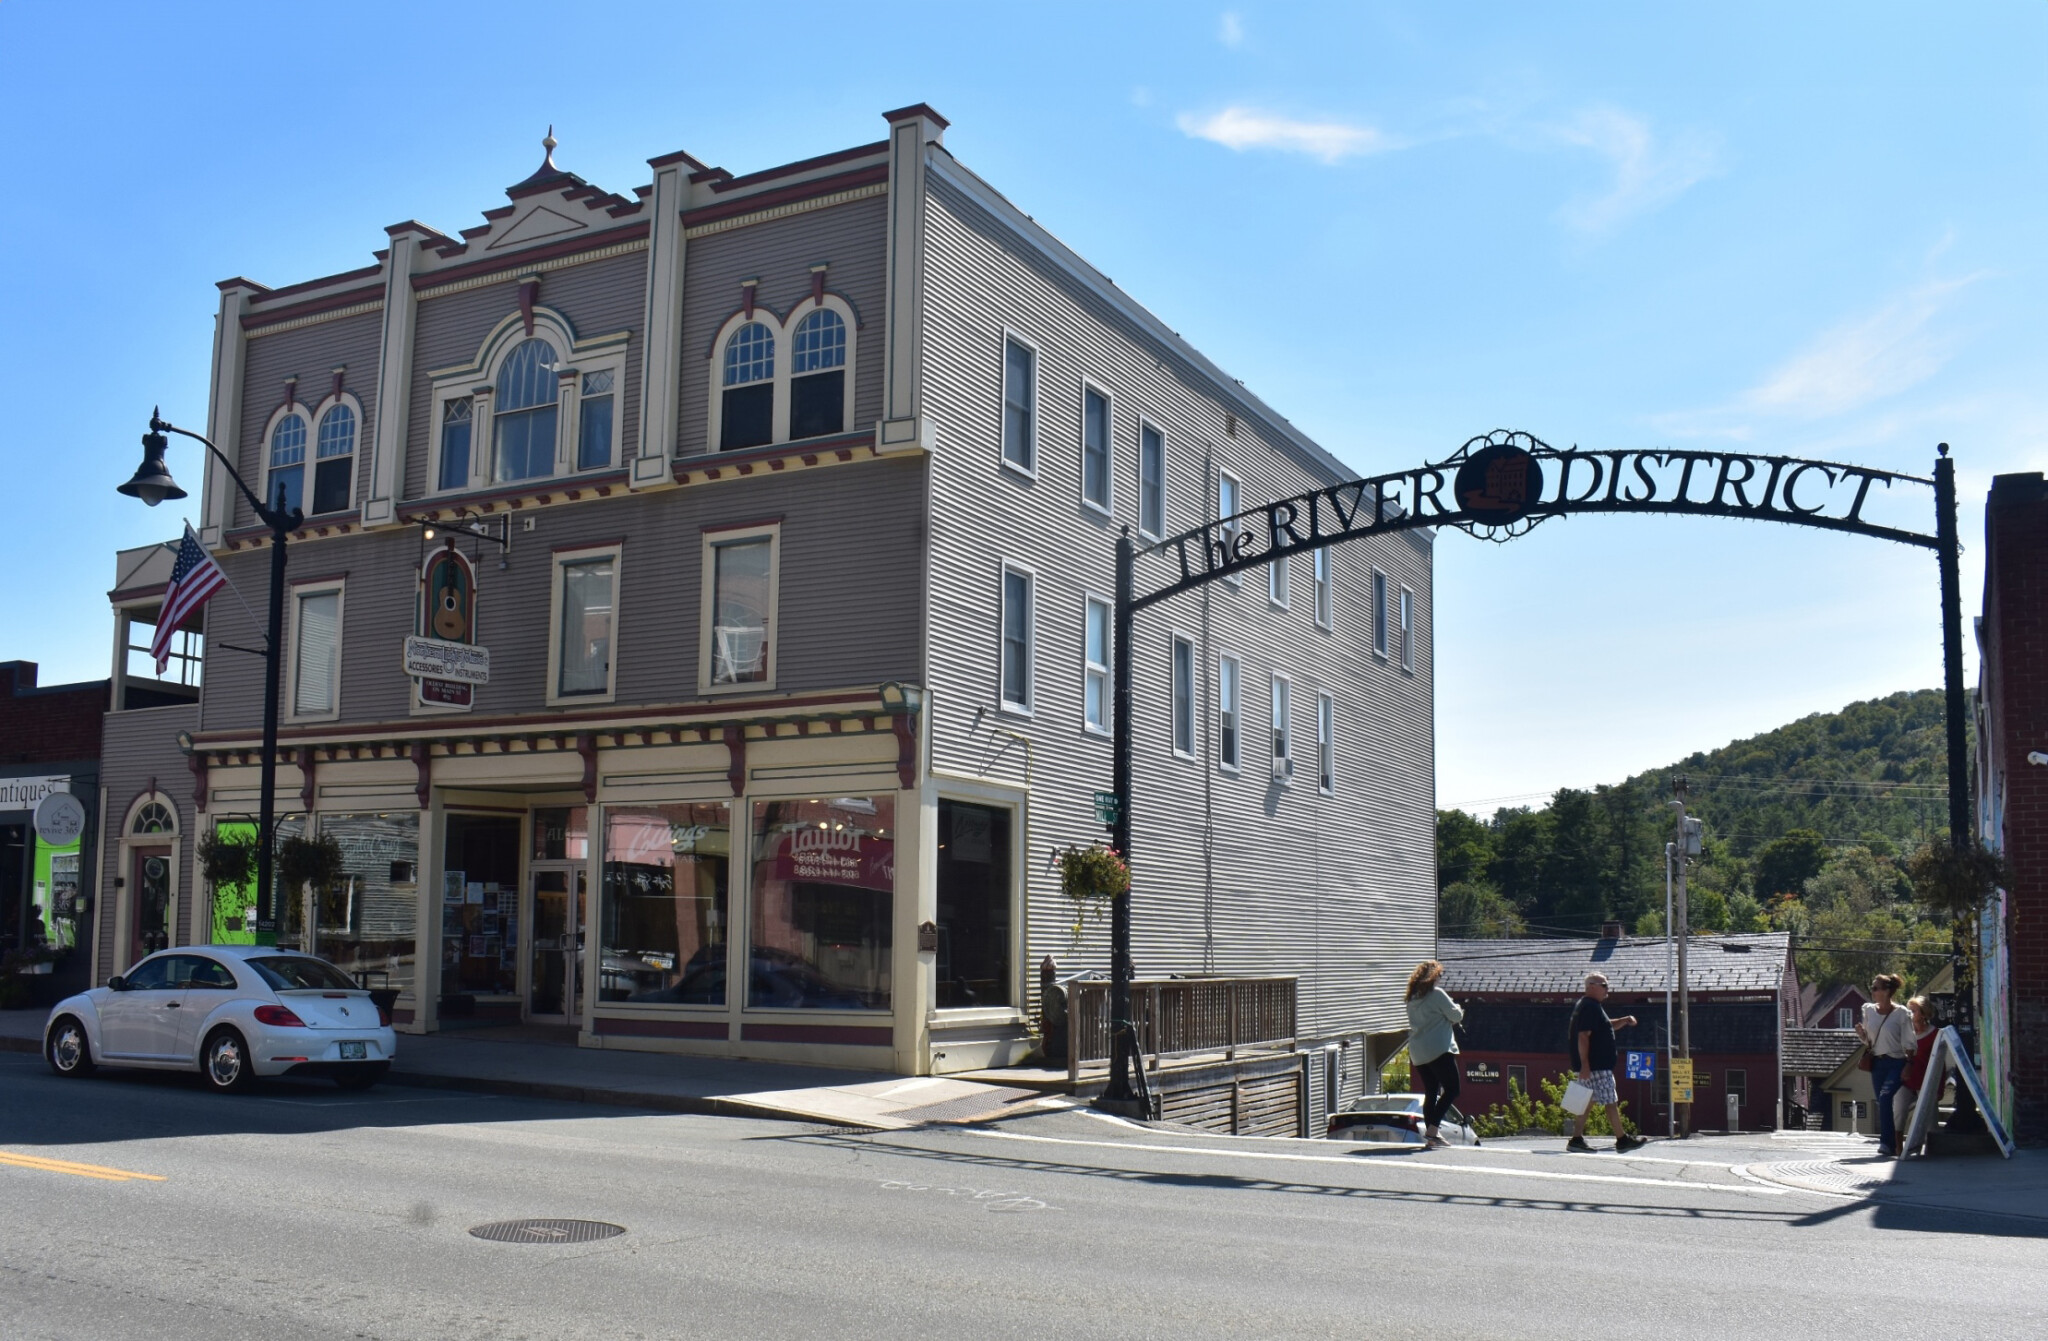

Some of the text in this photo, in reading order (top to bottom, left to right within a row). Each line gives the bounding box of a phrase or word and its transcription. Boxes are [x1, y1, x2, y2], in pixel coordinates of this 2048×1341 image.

[1167, 451, 1891, 584] The RIVER DISTRICT
[408, 661, 443, 674] ACCESSORIES
[454, 668, 487, 681] INSTRUMENTS
[0, 783, 54, 808] ntiques
[39, 826, 63, 834] revive
[781, 815, 865, 857] Taylor
[627, 822, 710, 860] Collings
[1628, 1053, 1639, 1065] P
[1466, 1070, 1499, 1078] SCHILLING
